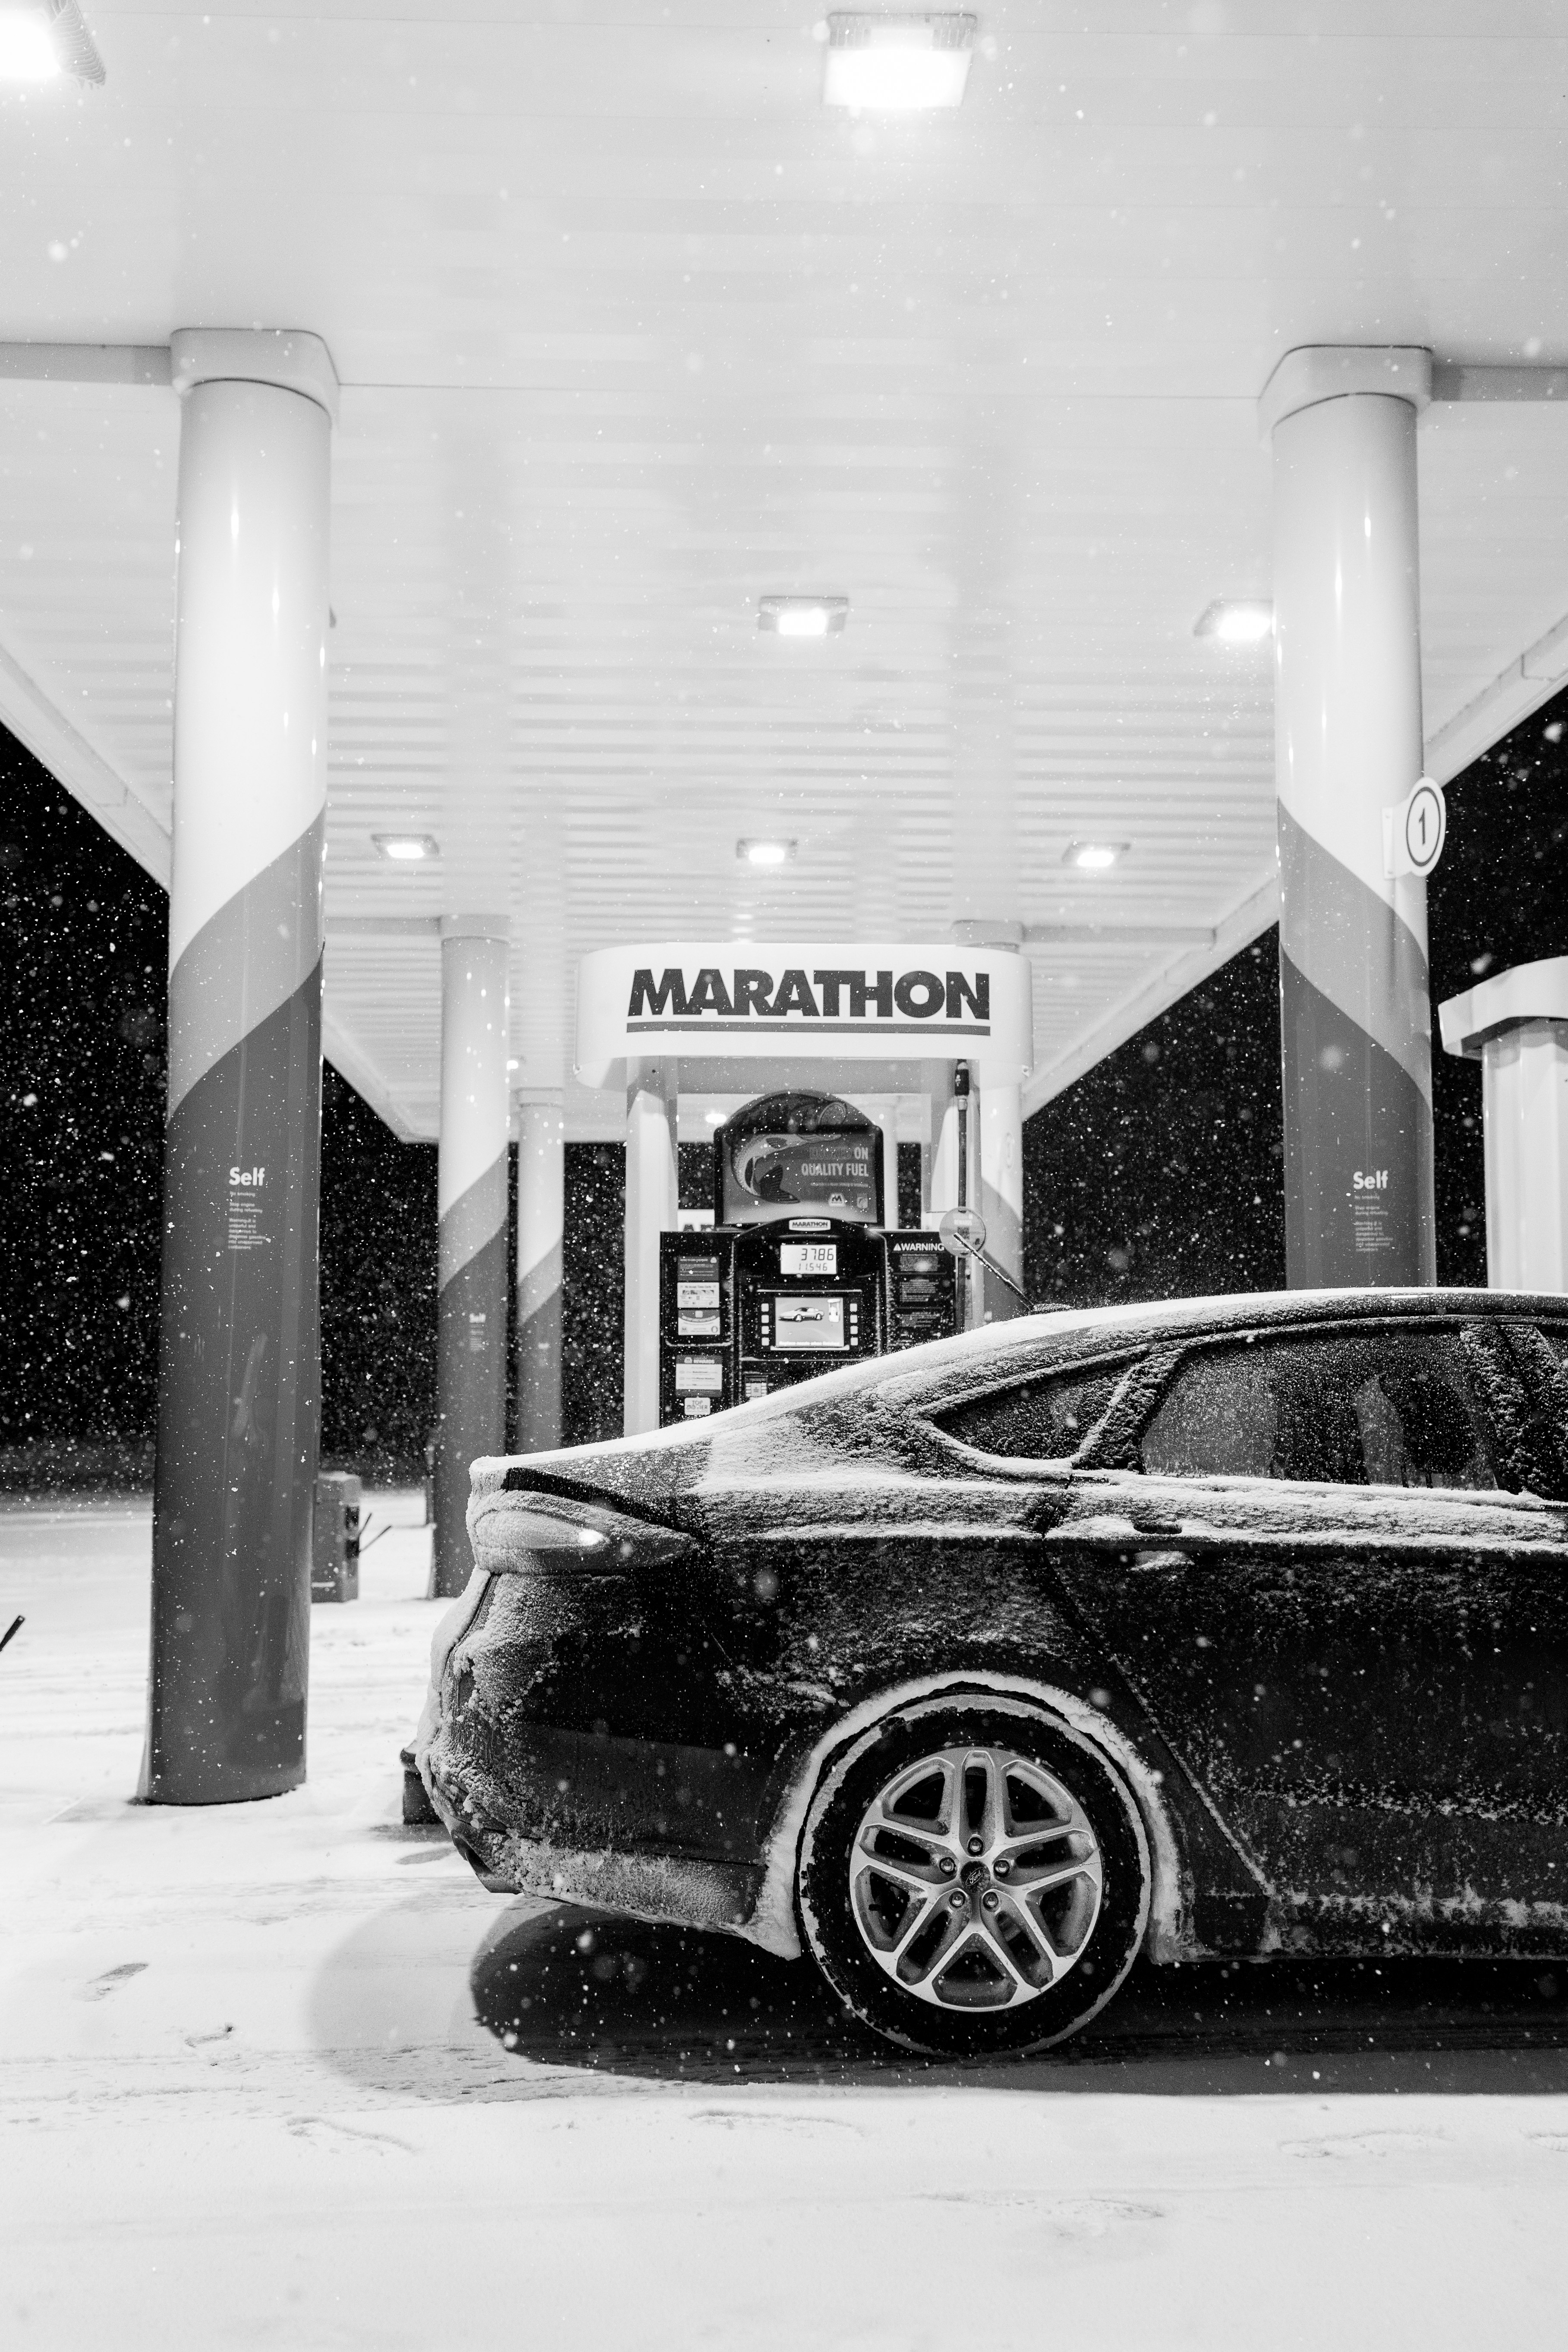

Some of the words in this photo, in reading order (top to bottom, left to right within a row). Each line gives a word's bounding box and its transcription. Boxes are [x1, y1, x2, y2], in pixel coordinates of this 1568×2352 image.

[1419, 808, 1425, 845] 1
[627, 968, 990, 1020] MARATHON
[853, 1146, 869, 1160] ON
[229, 1166, 265, 1186] Self
[801, 1163, 843, 1176] QUALITY
[846, 1163, 869, 1177] FUEL
[1353, 1170, 1389, 1190] Self
[900, 1243, 945, 1251] WARNING
[969, 1870, 981, 1884] Ford
